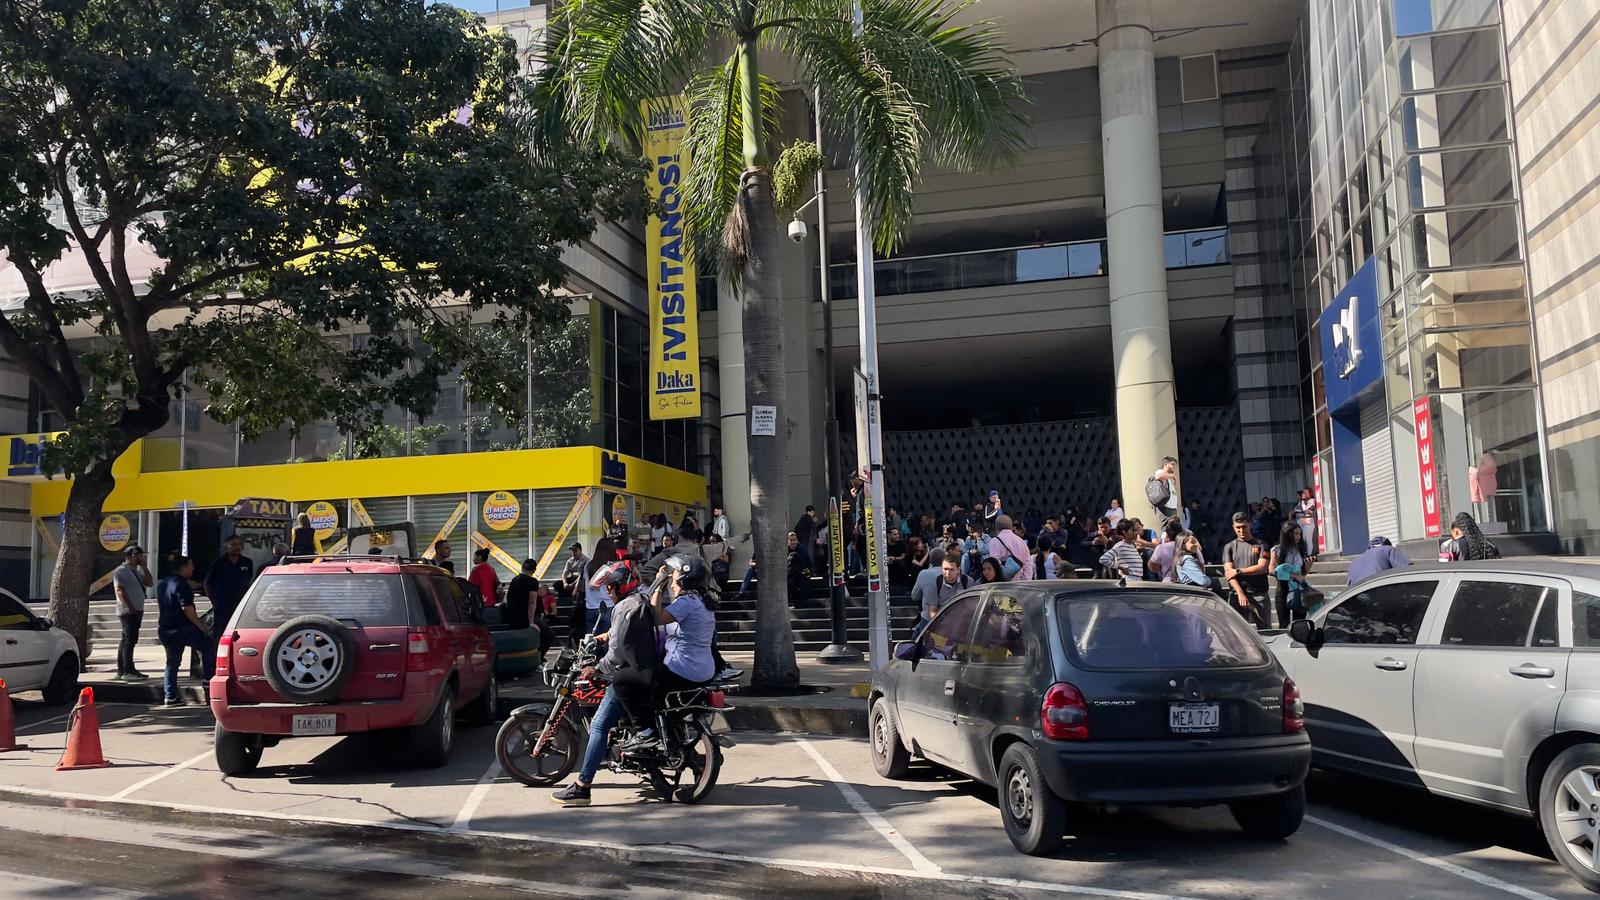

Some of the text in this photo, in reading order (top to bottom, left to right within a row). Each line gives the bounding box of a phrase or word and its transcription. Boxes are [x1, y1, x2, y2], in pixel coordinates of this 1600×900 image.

[656, 155, 687, 361] ¡VISÍTANOS!
[656, 370, 694, 389] Daka
[249, 500, 287, 515] TAXI
[869, 540, 877, 567] VOTA
[296, 719, 313, 729] TAK
[1172, 710, 1217, 726] MEA 72J
